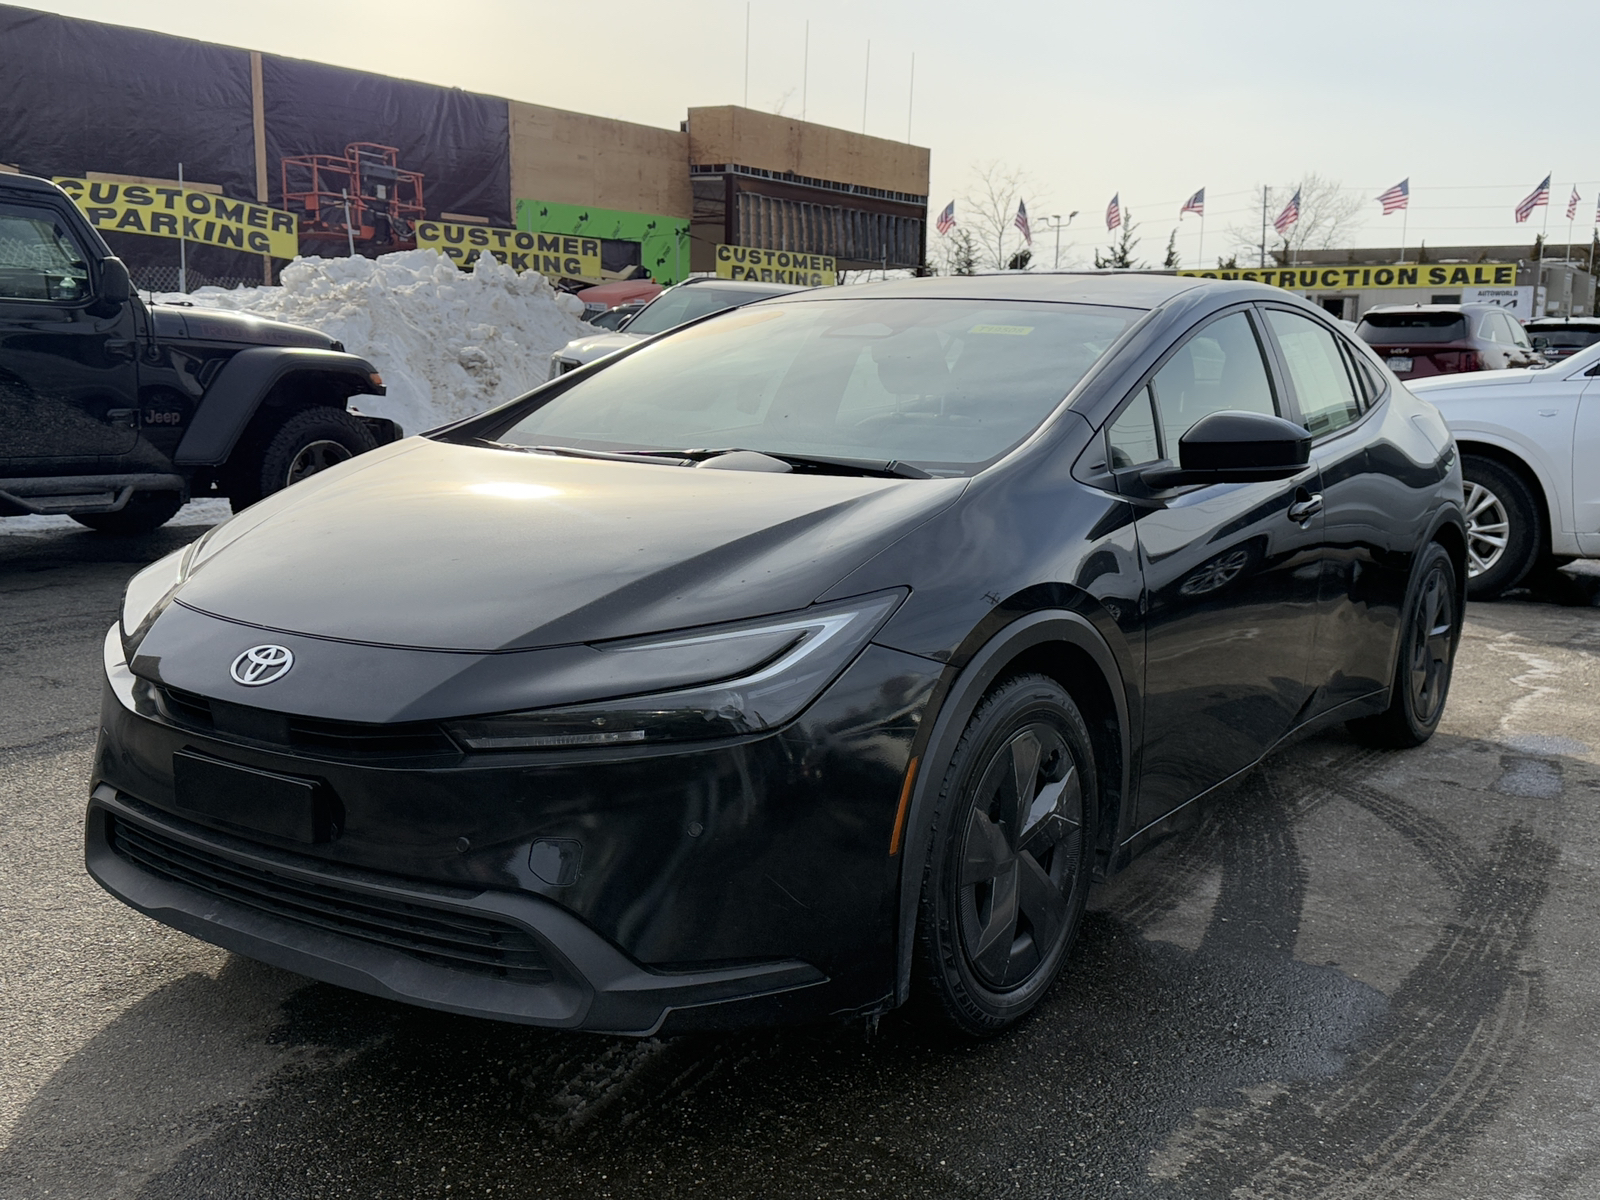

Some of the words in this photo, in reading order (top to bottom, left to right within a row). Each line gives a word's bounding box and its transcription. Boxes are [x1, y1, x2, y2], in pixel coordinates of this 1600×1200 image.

[56, 180, 294, 235] CUSTOMER
[85, 207, 271, 253] PARKING
[418, 223, 598, 257] CUSTOMER
[718, 246, 833, 272] CUSTOMER
[731, 265, 823, 287] PARKING
[1182, 268, 1418, 287] STRUCTION
[1428, 266, 1513, 285] SALE
[145, 409, 181, 426] Jeep
